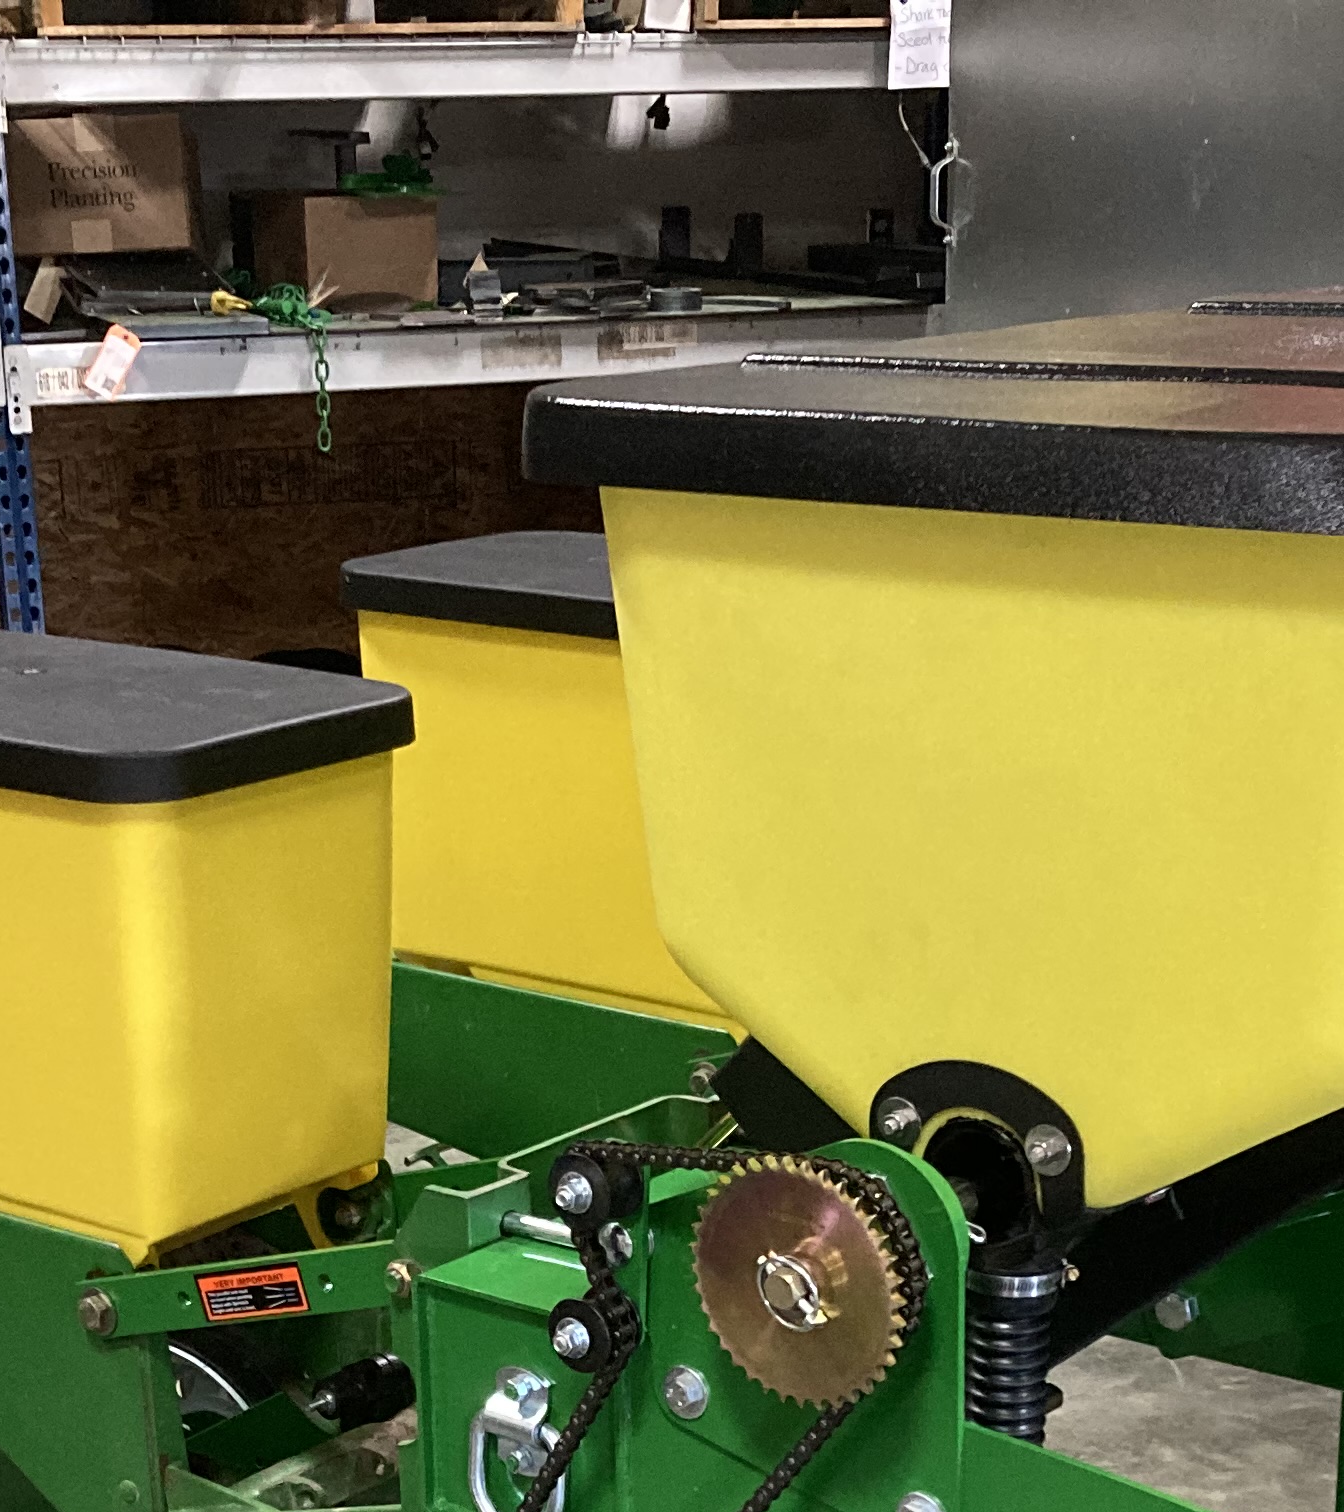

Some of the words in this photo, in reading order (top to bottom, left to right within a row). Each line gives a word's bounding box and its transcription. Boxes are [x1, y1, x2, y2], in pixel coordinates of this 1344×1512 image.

[905, 56, 939, 82] Drag
[47, 158, 137, 182] Precision
[50, 185, 136, 212] Planting
[213, 1279, 234, 1289] VERY
[236, 1272, 284, 1286] IMPORTANT
